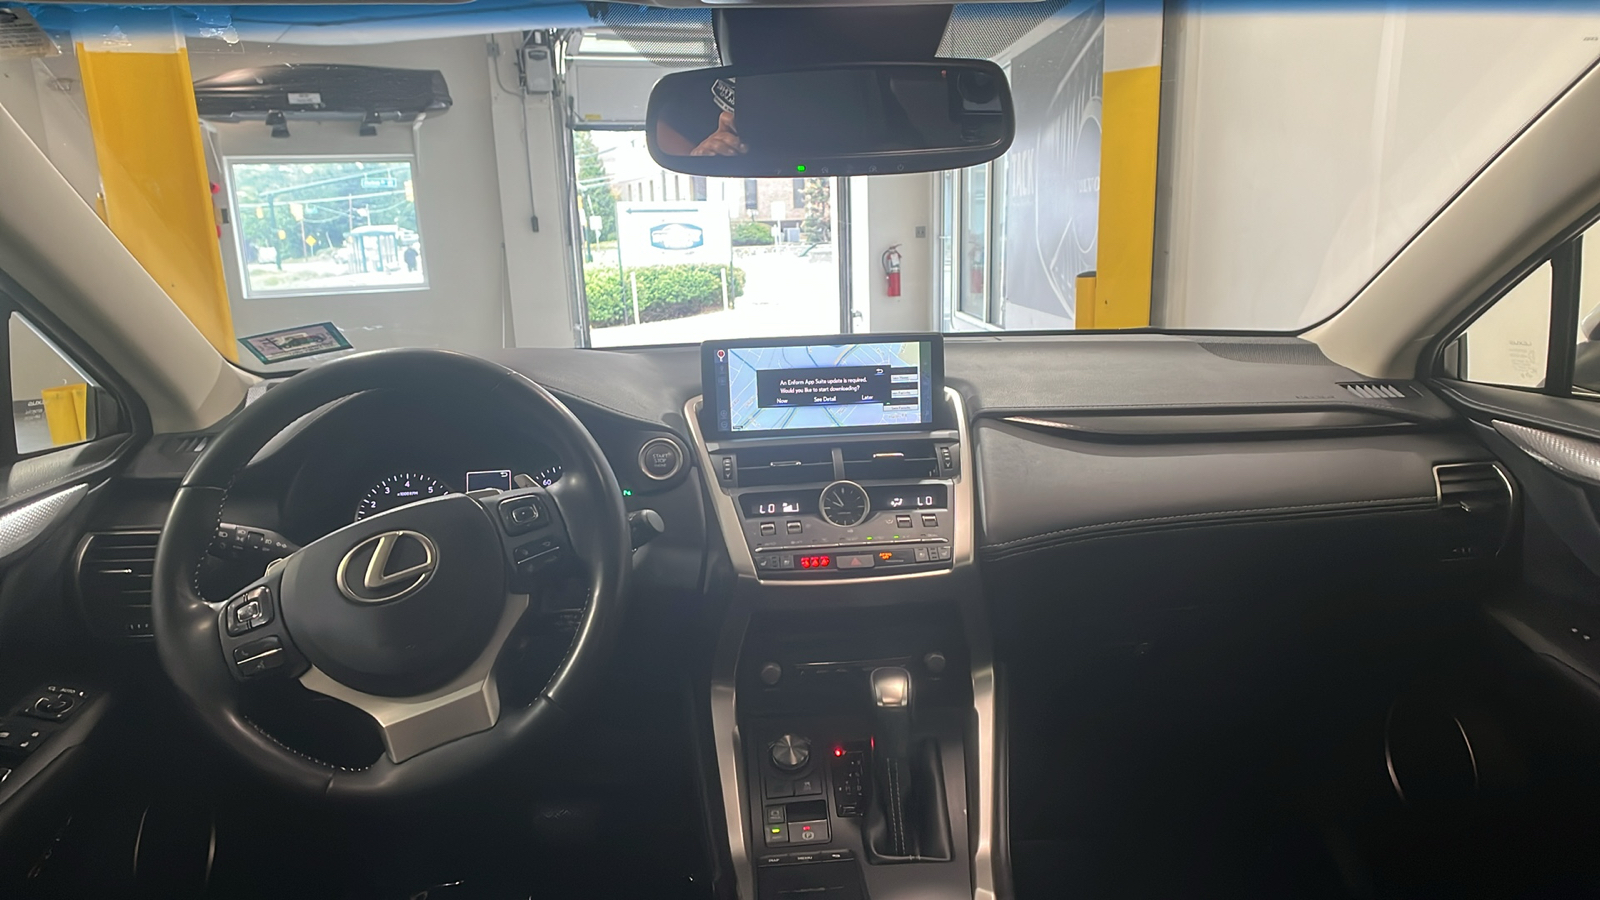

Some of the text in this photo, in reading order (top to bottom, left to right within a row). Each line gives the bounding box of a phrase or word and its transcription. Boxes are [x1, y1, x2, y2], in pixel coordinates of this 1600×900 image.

[787, 378, 804, 386] Enform
[805, 379, 814, 387] App
[827, 377, 843, 385] update
[829, 385, 860, 393] downloading?
[404, 480, 411, 488] 4
[542, 478, 552, 486] 60
[384, 486, 391, 494] 3
[427, 486, 434, 494] 5
[370, 500, 377, 509] 2
